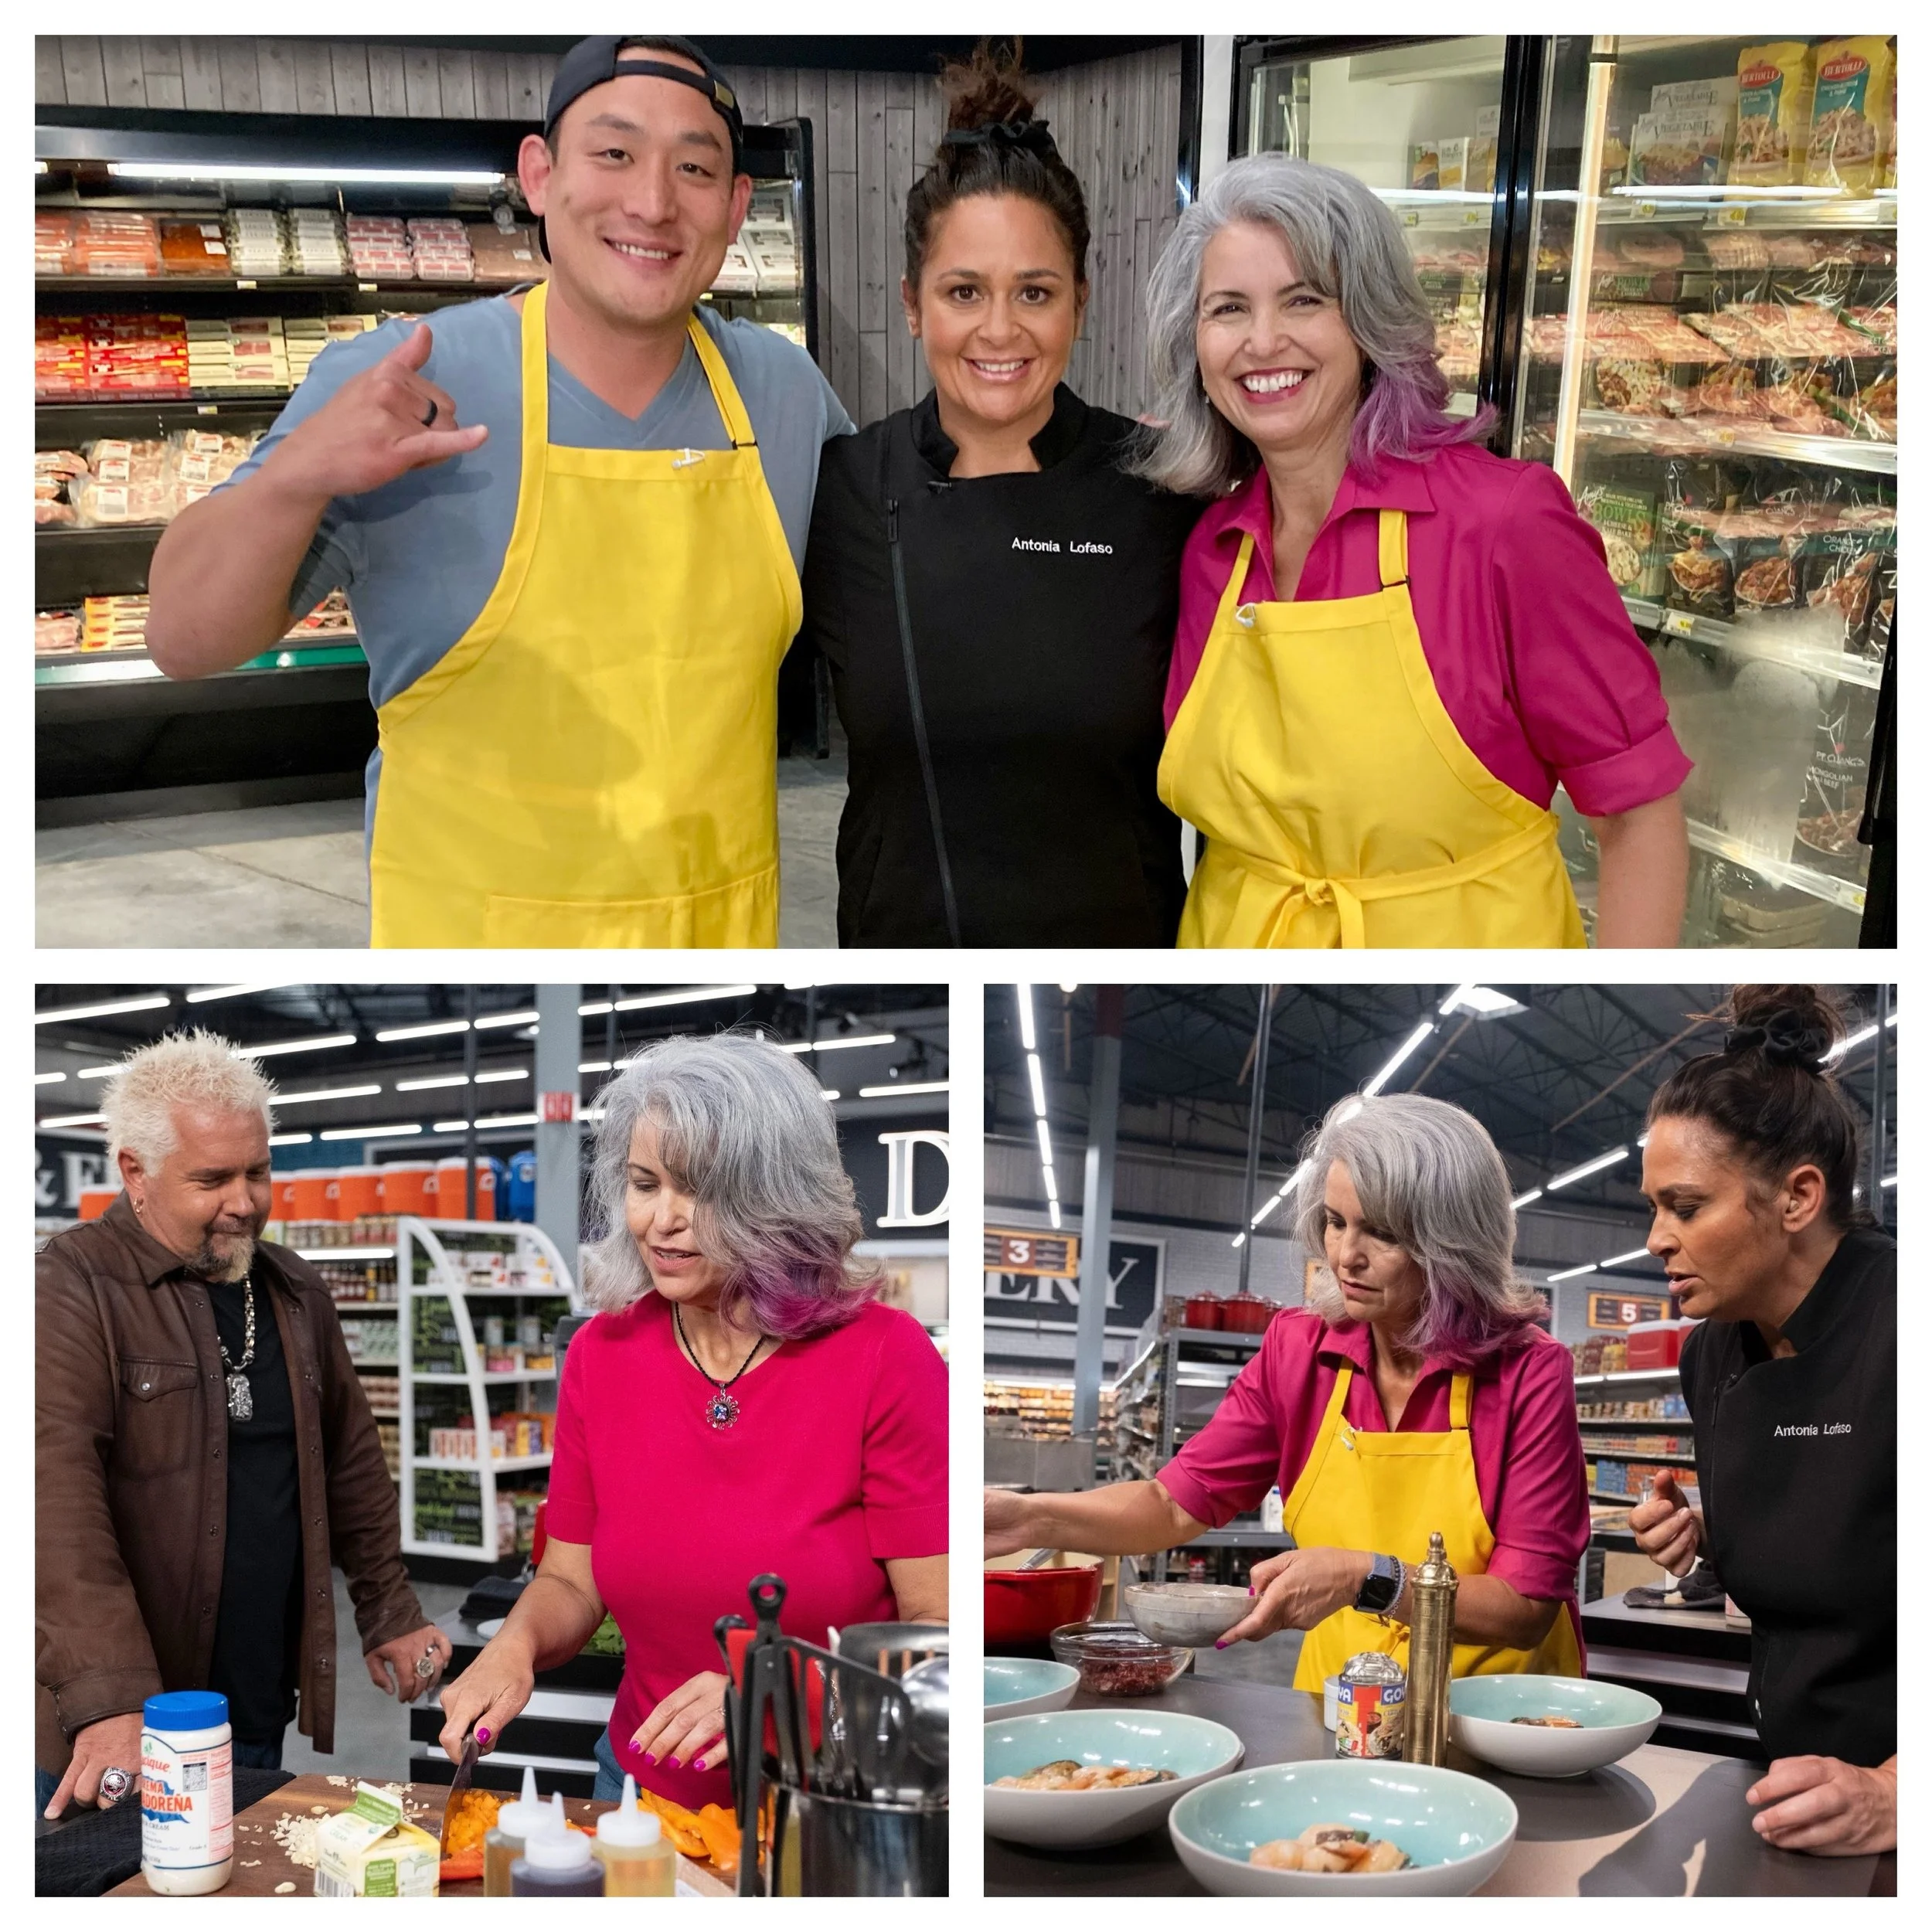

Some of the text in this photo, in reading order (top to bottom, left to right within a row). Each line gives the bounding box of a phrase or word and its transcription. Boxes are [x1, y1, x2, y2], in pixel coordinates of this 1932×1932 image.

[1740, 70, 1776, 83] BERTOLLI
[1825, 60, 1862, 77] BERTOLLI
[1011, 537, 1114, 554] Antonia Lofaso
[1008, 1240, 1030, 1264] 3
[1621, 1302, 1637, 1322] 5
[1774, 1422, 1852, 1437] Antonia Lofaso
